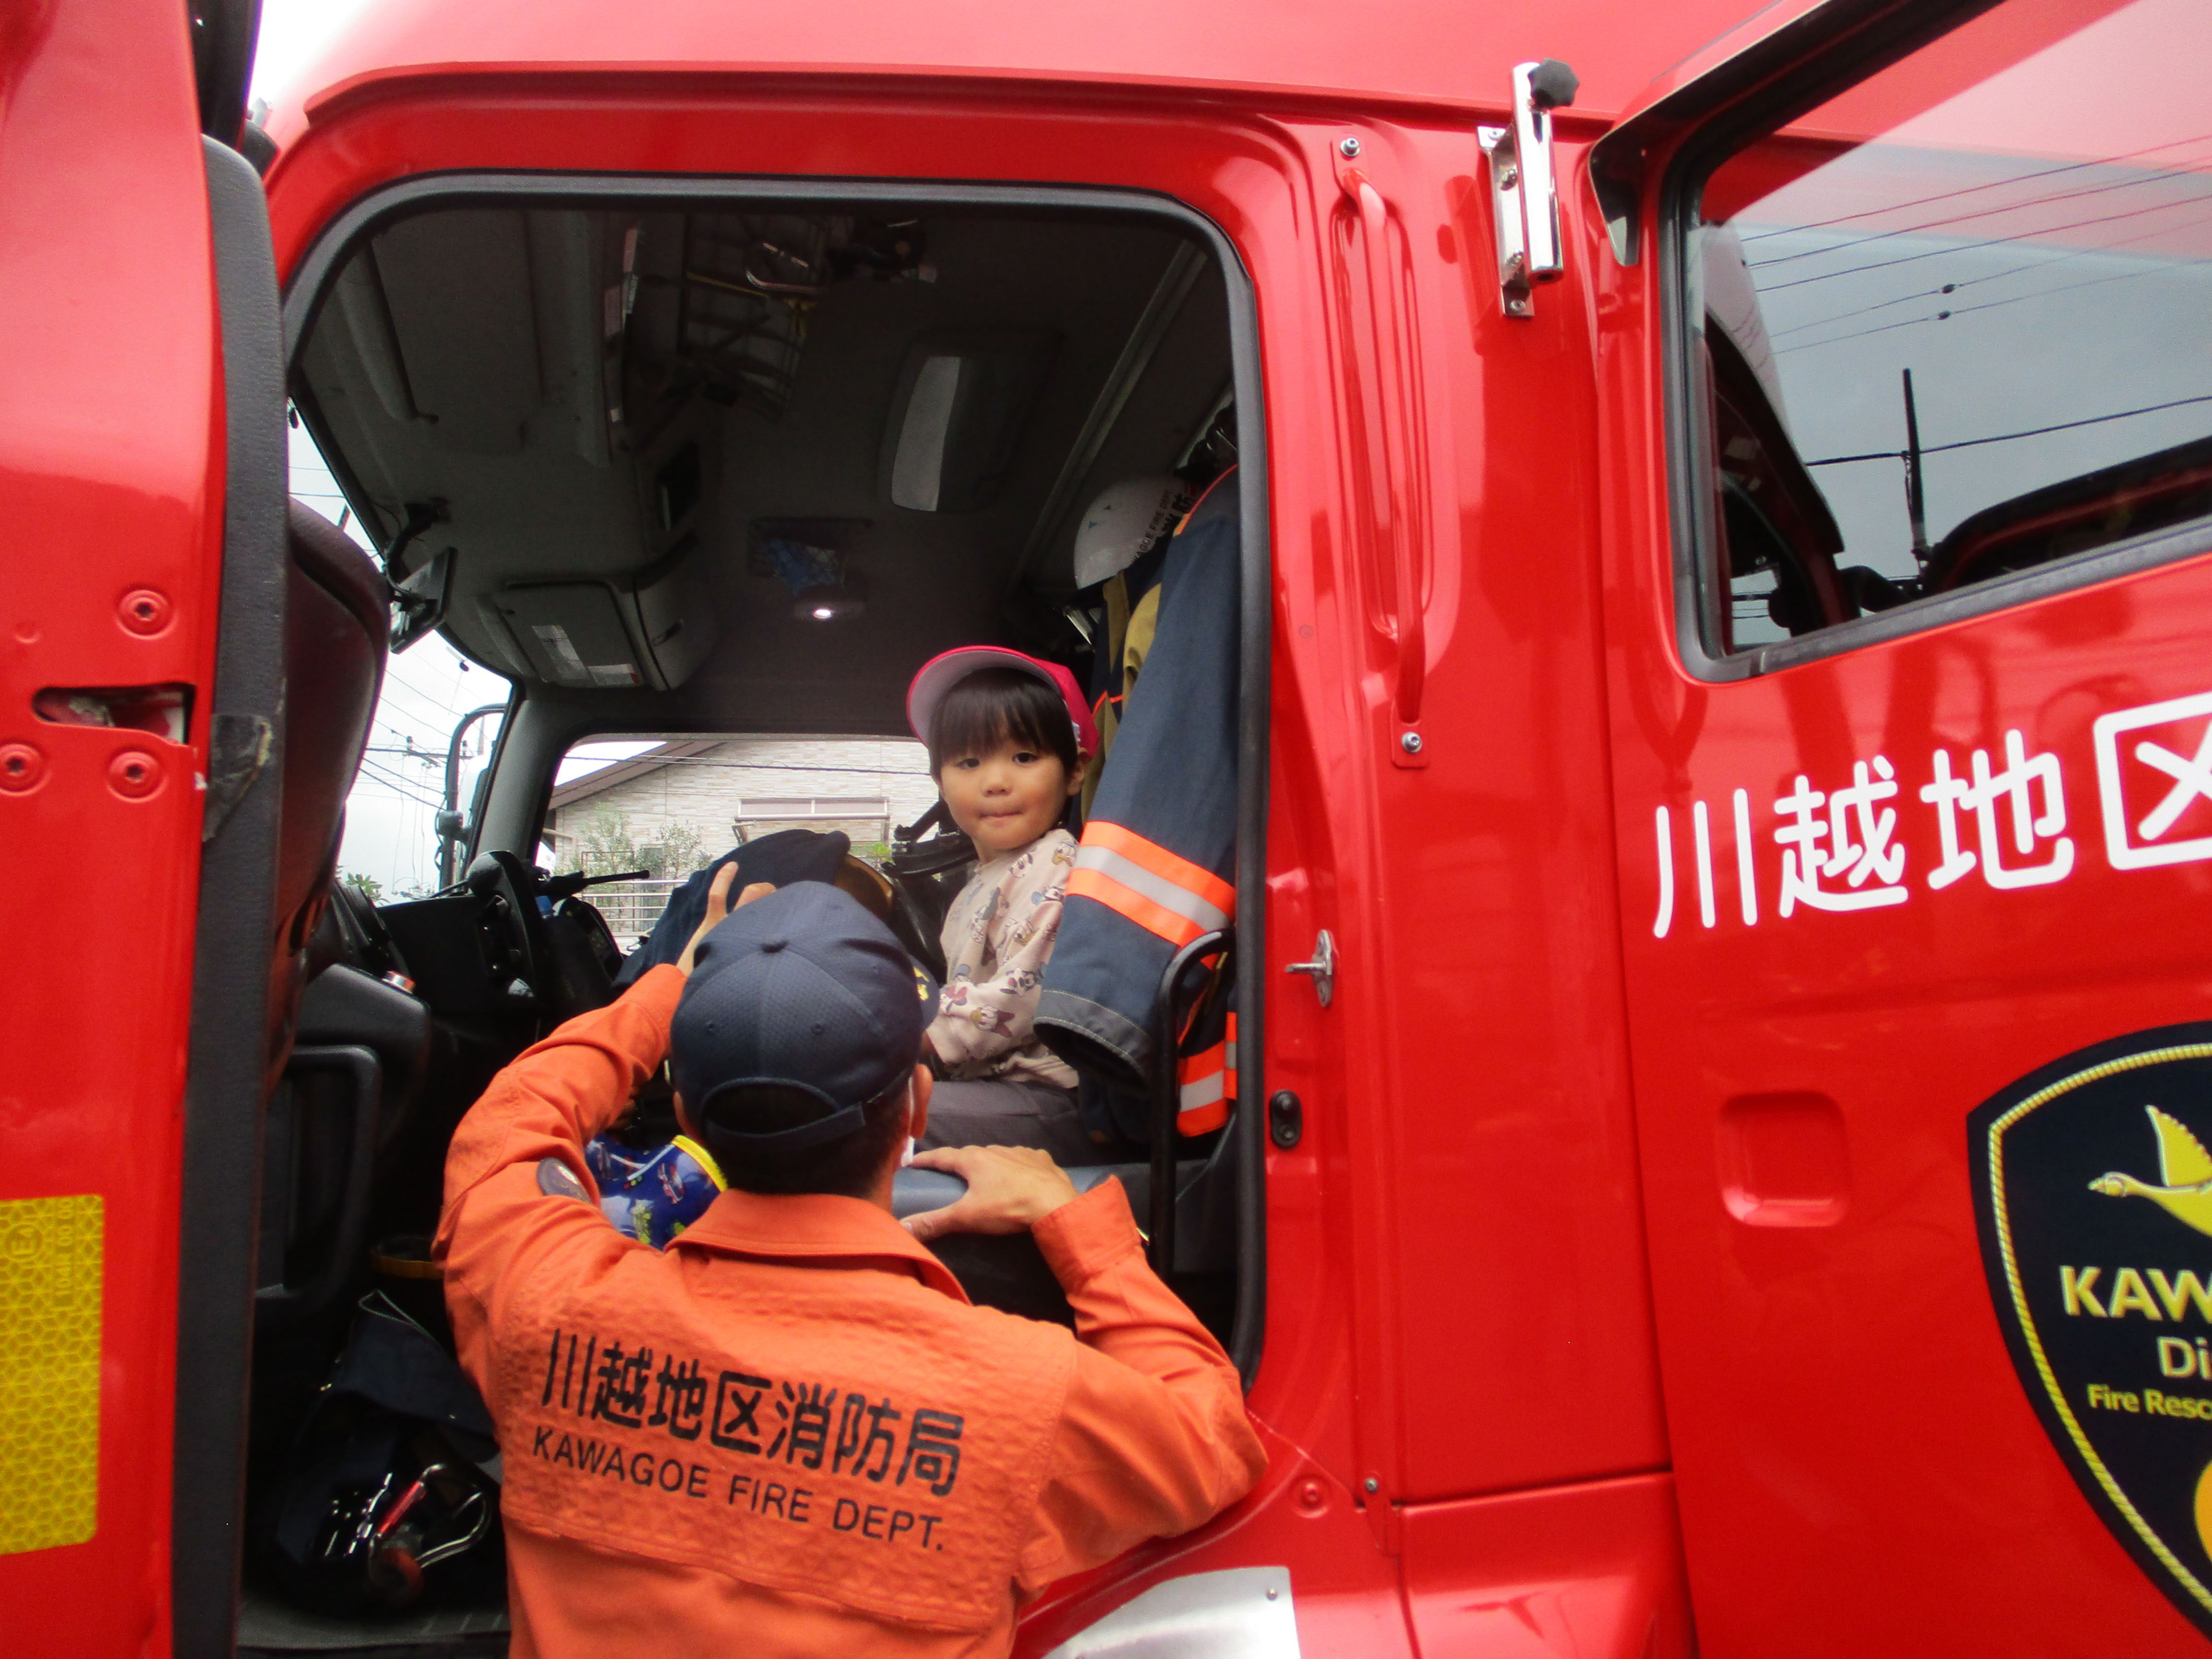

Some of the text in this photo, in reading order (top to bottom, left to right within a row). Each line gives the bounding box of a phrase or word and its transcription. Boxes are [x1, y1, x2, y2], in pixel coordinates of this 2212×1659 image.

[1654, 691, 2212, 938] 川越地区
[2059, 1265, 2212, 1324] KAW
[2087, 1383, 2140, 1414] Fire
[2157, 1336, 2212, 1381] Di
[542, 1328, 964, 1497] 川越地区消防局
[532, 1426, 944, 1551] KAWAGOE FIRE DEPT.
